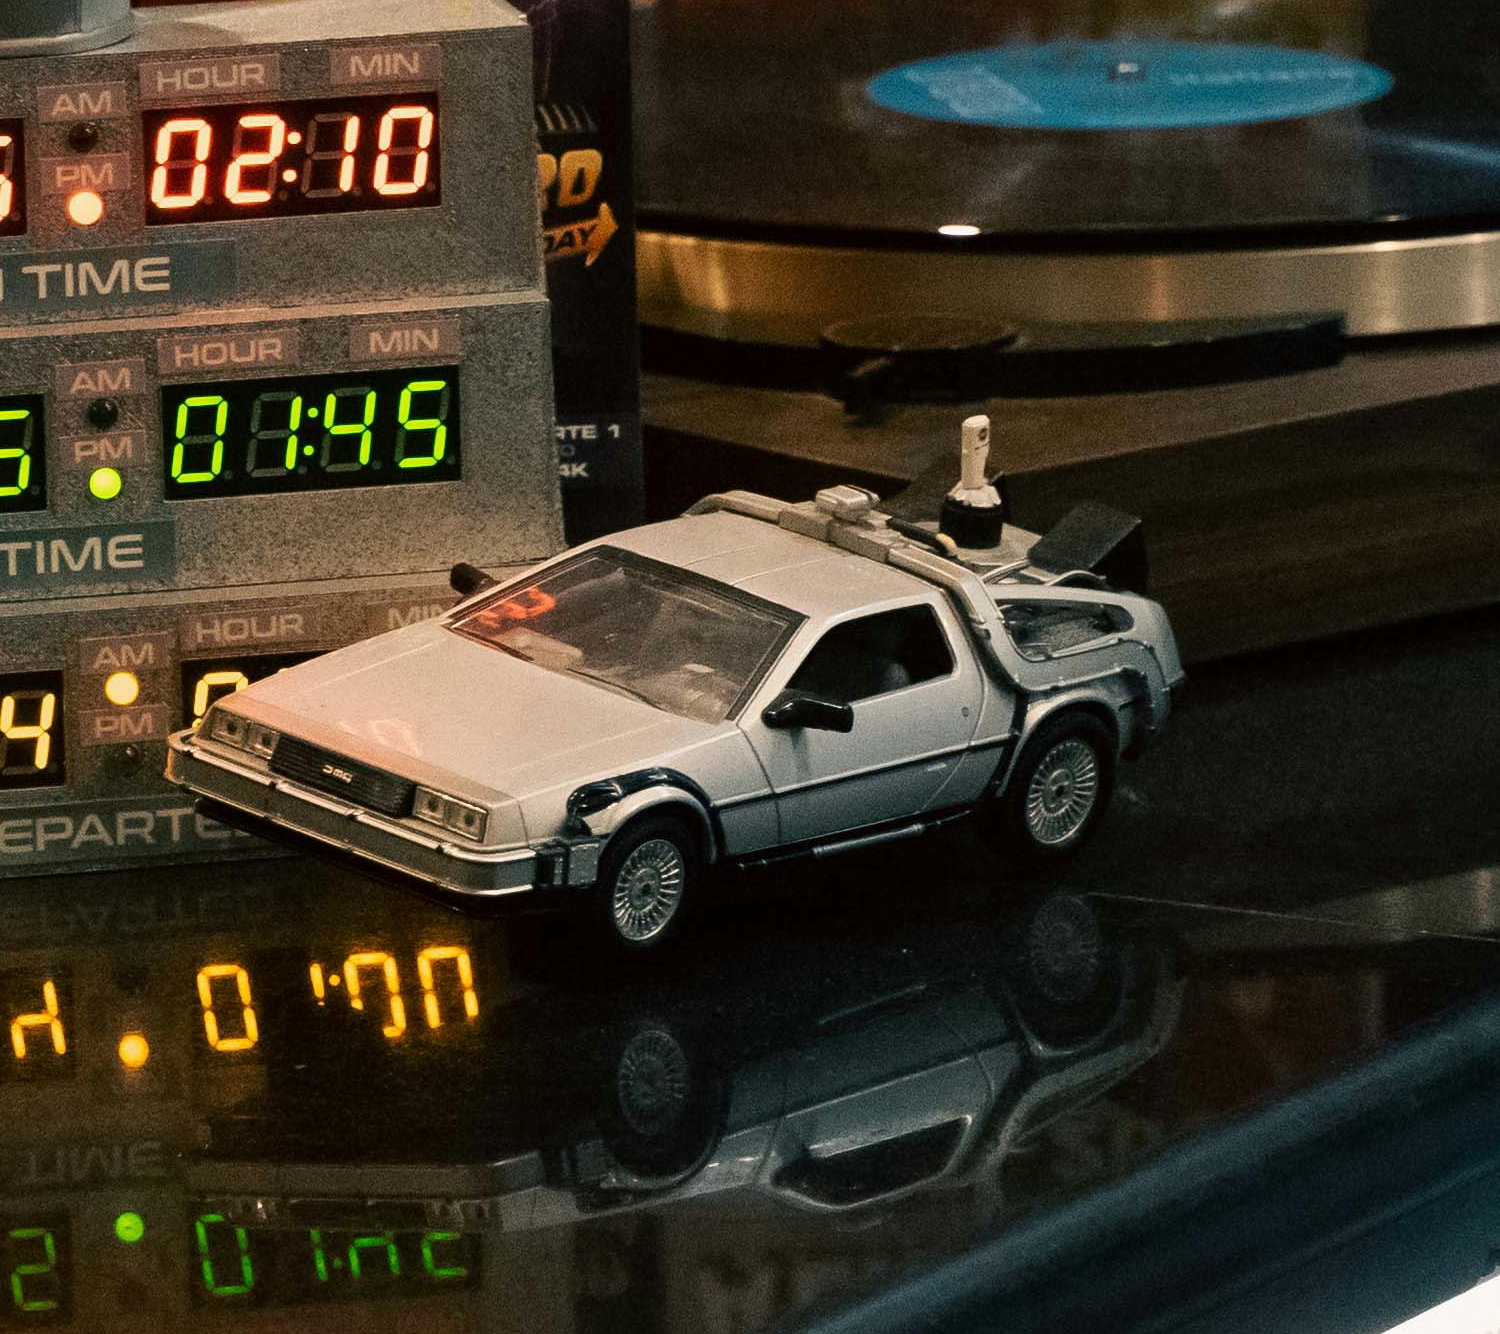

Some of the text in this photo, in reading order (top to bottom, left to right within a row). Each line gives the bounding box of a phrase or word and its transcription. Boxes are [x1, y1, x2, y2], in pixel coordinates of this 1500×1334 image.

[51, 89, 111, 115] AM
[156, 63, 265, 94] HOUR
[350, 52, 421, 78] MIN
[55, 161, 113, 187] PM
[150, 105, 436, 211] 02:10
[23, 256, 172, 300] TIME
[70, 368, 131, 393] AM
[173, 337, 283, 368] HOUR
[368, 327, 440, 354] MIN
[73, 436, 132, 463] PM
[170, 379, 447, 484] 01:45
[93, 642, 155, 668] AM
[195, 613, 304, 644] HOUR
[95, 713, 154, 737] PM
